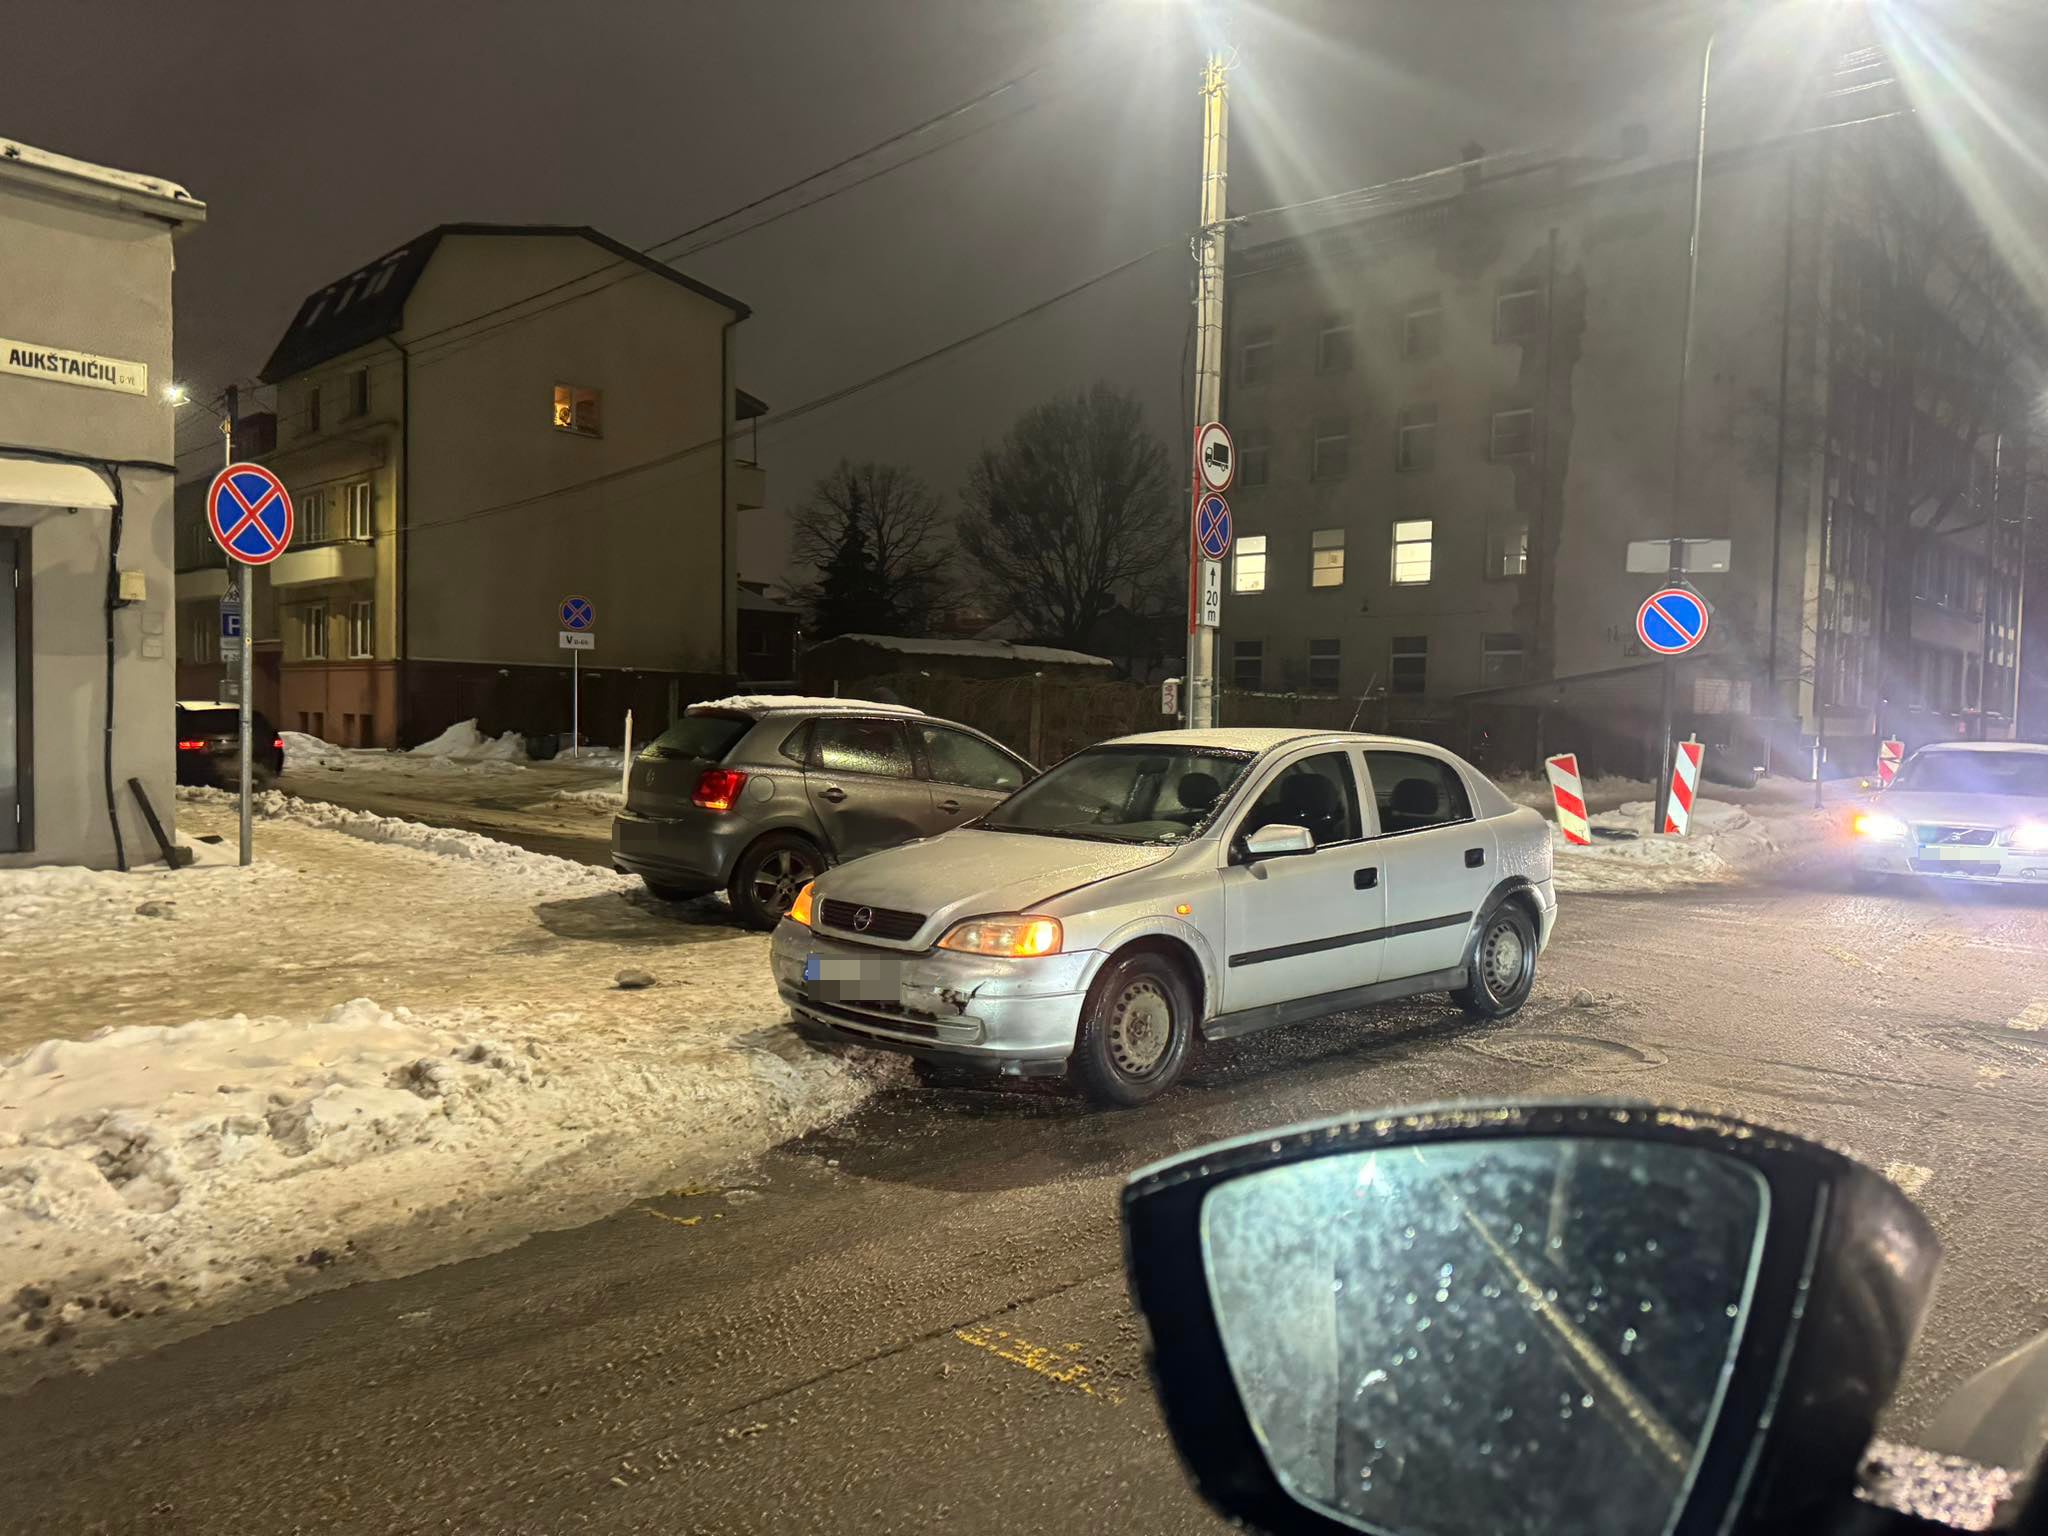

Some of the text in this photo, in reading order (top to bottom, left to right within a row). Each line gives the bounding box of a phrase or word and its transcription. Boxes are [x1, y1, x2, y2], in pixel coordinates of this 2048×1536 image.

[9, 349, 116, 385] AUKŠTAIČIŲ
[1206, 590, 1218, 606] 20
[1207, 610, 1216, 622] m
